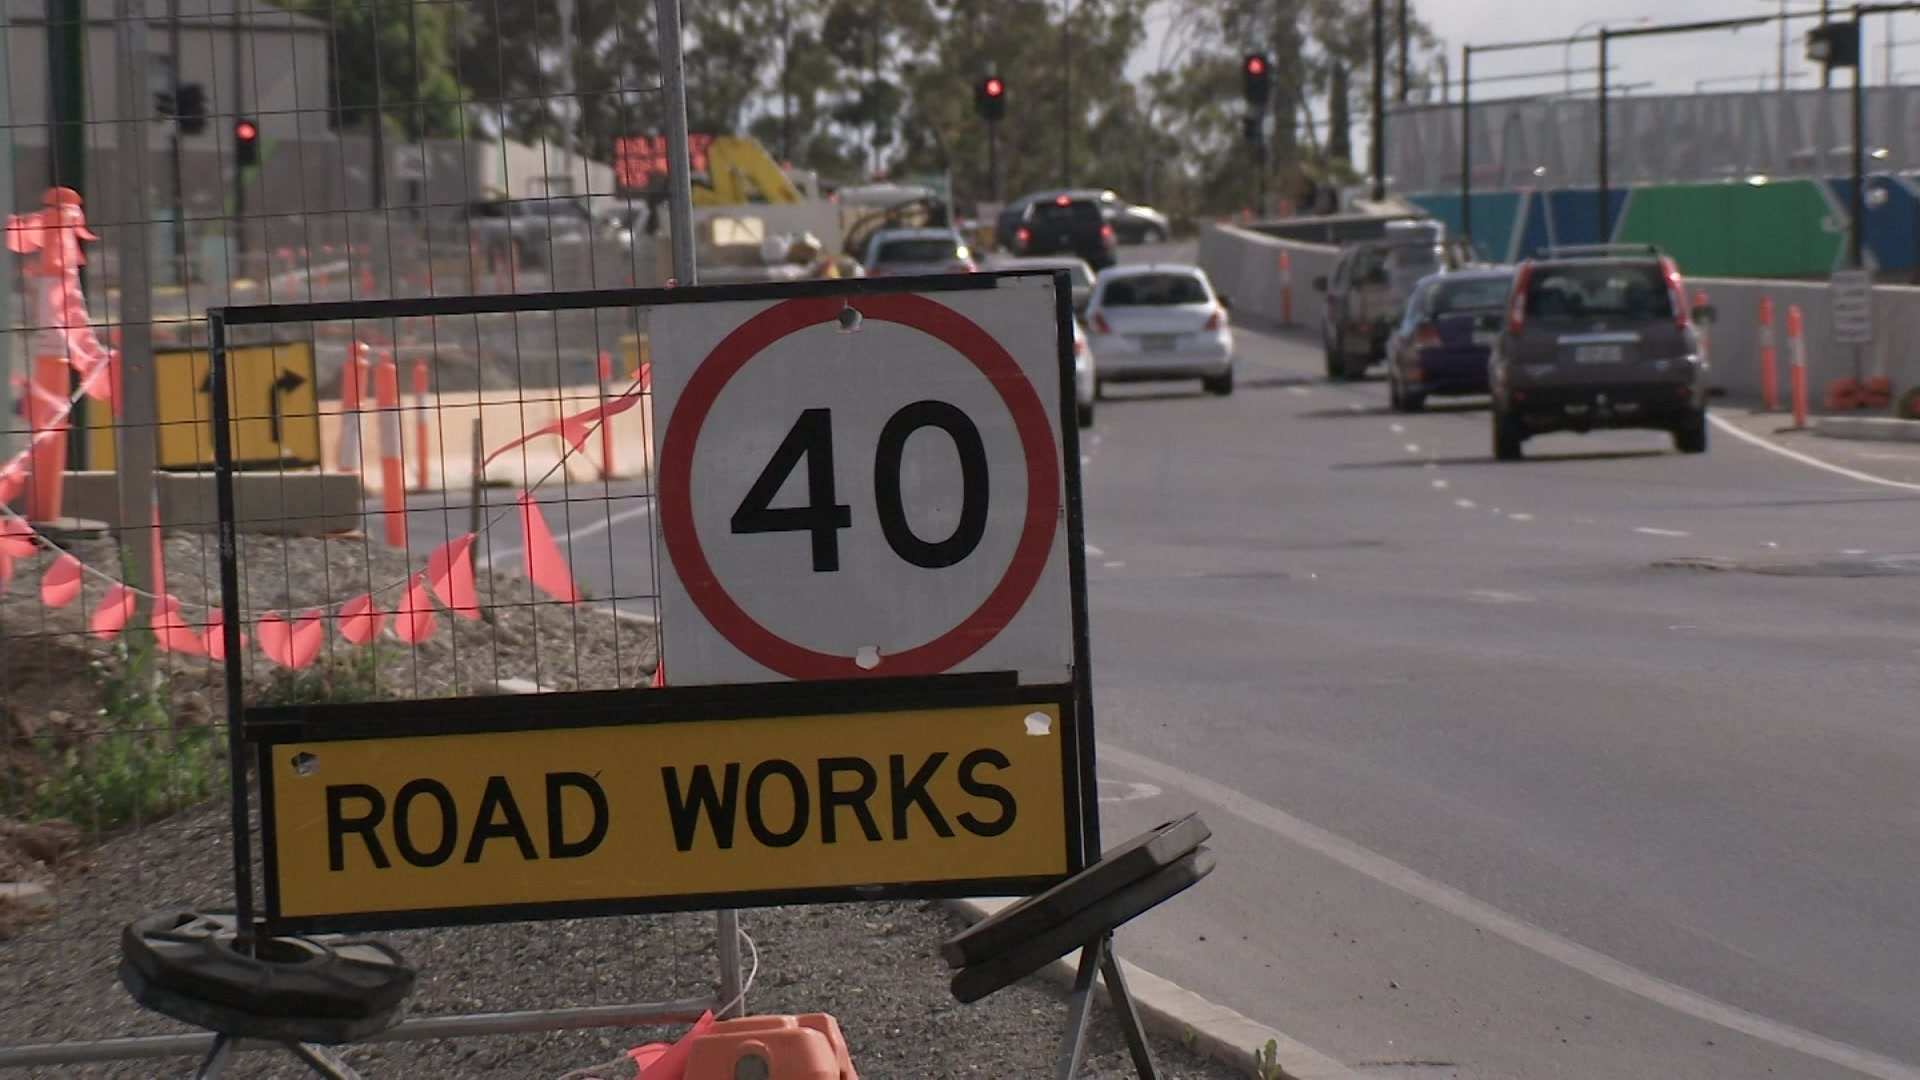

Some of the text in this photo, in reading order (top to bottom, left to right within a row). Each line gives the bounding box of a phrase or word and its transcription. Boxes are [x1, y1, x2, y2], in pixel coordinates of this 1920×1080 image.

[730, 398, 990, 574] 40
[324, 748, 1018, 873] ROAD WORKS
